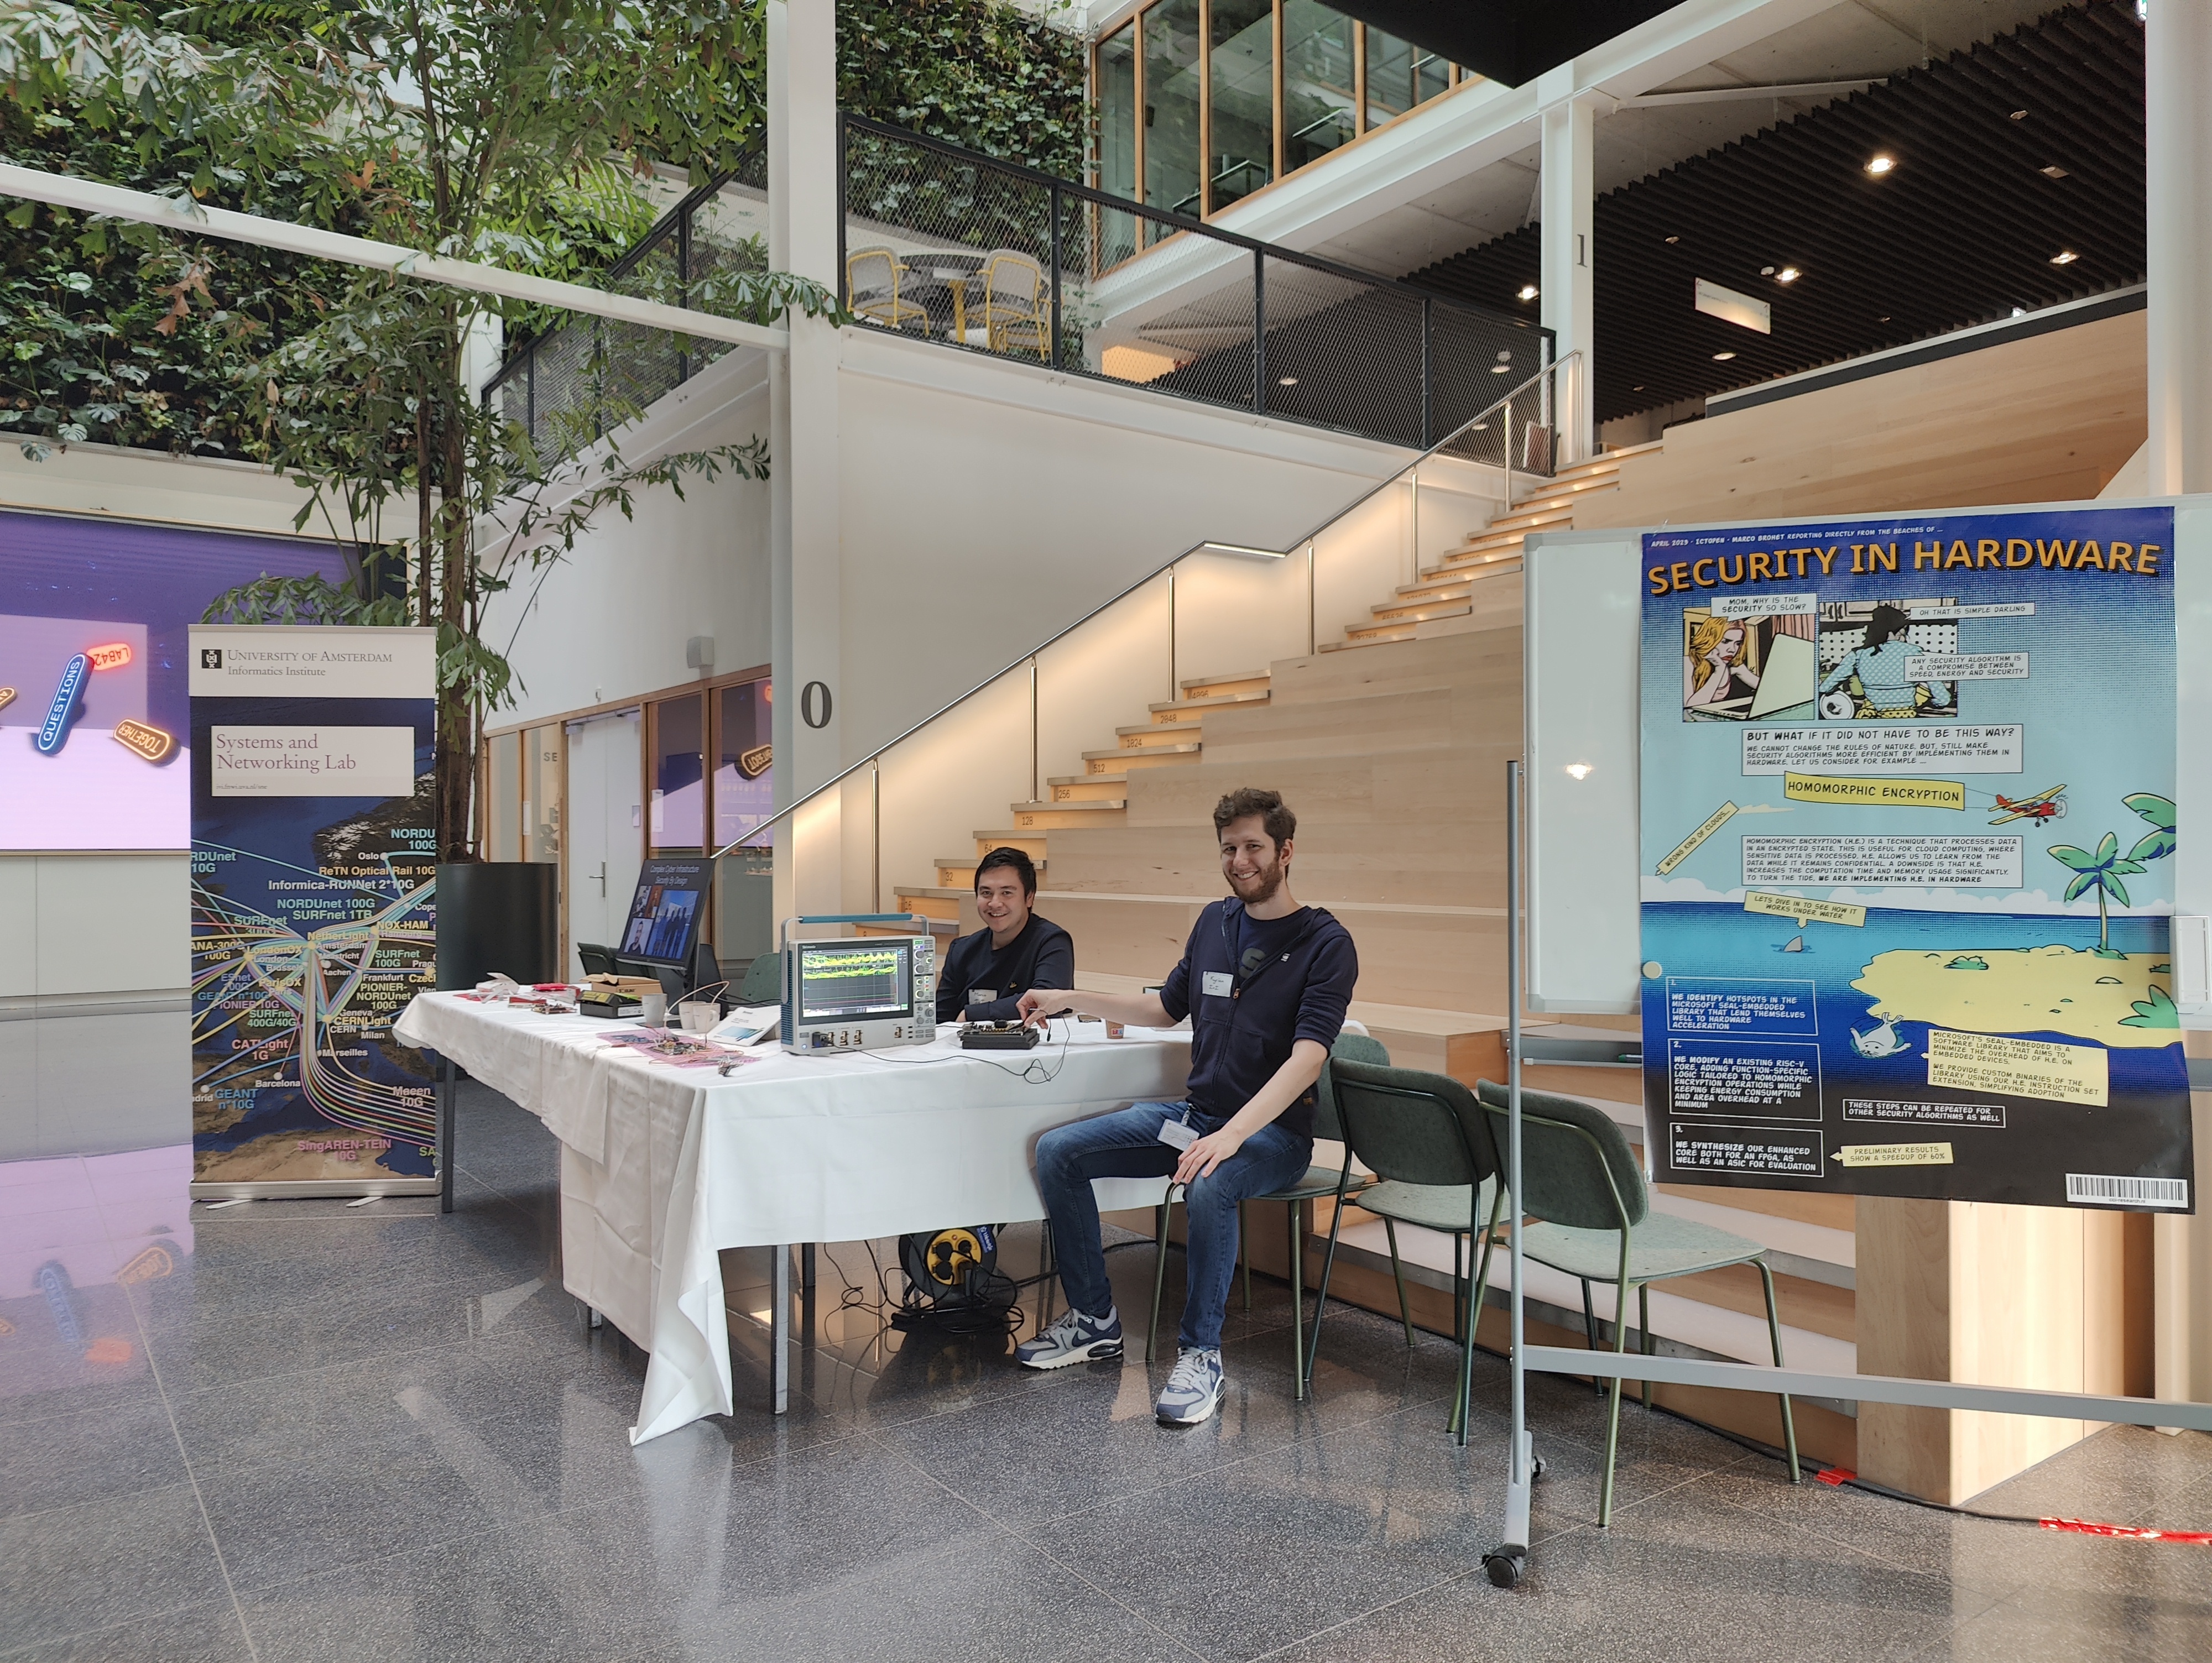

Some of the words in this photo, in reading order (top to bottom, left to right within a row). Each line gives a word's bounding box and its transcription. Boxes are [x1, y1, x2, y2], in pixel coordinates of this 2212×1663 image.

[1576, 234, 1587, 268] 1
[1648, 546, 1837, 595] SECURITY
[1850, 542, 1897, 573] IN
[1914, 539, 2161, 576] HARDWARE
[93, 647, 129, 666] LAB42
[228, 650, 299, 661] UNIVERSITY
[302, 652, 317, 661] OF
[320, 651, 392, 662] AMSTERDAM
[228, 666, 283, 675] Informatics
[286, 666, 326, 676] Institute
[43, 661, 80, 741] QUESTIONS
[801, 681, 832, 729] 0
[118, 724, 161, 753] TOGETHER
[1747, 732, 1769, 741] BUT
[1775, 731, 1804, 740] WHAT
[1809, 731, 1817, 740] IF
[1822, 731, 1832, 740] IT
[1837, 731, 1853, 740] DID
[1858, 730, 1879, 739] NOT
[1884, 730, 1911, 739] HAVE
[1916, 729, 1929, 739] TO
[1935, 729, 1949, 738] BE
[1955, 729, 1979, 738] THIS
[1985, 728, 2014, 738] WAY?
[216, 734, 283, 752] Systems
[288, 734, 318, 749] and
[217, 754, 320, 774] Networking
[325, 754, 356, 769] Lab
[1093, 763, 1105, 773] 512
[1058, 789, 1071, 799] 256
[1788, 781, 1876, 796] HOMOMORPHIC
[1882, 787, 1959, 802] ENCRYPTION
[1022, 816, 1034, 825] 128
[391, 829, 436, 839] NORDU
[1684, 837, 1697, 850] KIND
[1697, 829, 1704, 838] OF
[984, 844, 992, 853] 64
[358, 852, 379, 860] Oslo
[191, 863, 216, 872] 10G
[319, 866, 348, 875] ReTN
[351, 866, 388, 877] Optical
[393, 866, 413, 875] Rail
[416, 866, 436, 875] 10G
[946, 872, 953, 881] 32
[277, 899, 342, 908] NORDUnet
[346, 898, 375, 908] 100G
[905, 901, 912, 910] 16
[293, 910, 346, 920] SURFnet
[349, 910, 372, 919] 1TB
[377, 921, 428, 929] NOX-HAM
[375, 950, 420, 959] SURFnet
[259, 978, 301, 986] ParisOX
[360, 983, 408, 991] PIONIER-
[357, 992, 411, 1001] NORDUnet
[261, 1000, 279, 1008] 10G
[371, 1001, 397, 1010] 100G
[247, 1018, 296, 1027] 400G/40G
[334, 1016, 392, 1026] CERNLight
[252, 1051, 269, 1060] 1G
[215, 1089, 258, 1099] GEANT
[393, 1086, 431, 1096] Maeen
[400, 1097, 424, 1106] 10G
[298, 1139, 392, 1153] SingAREN-TEIN
[334, 1151, 357, 1160] 10G
